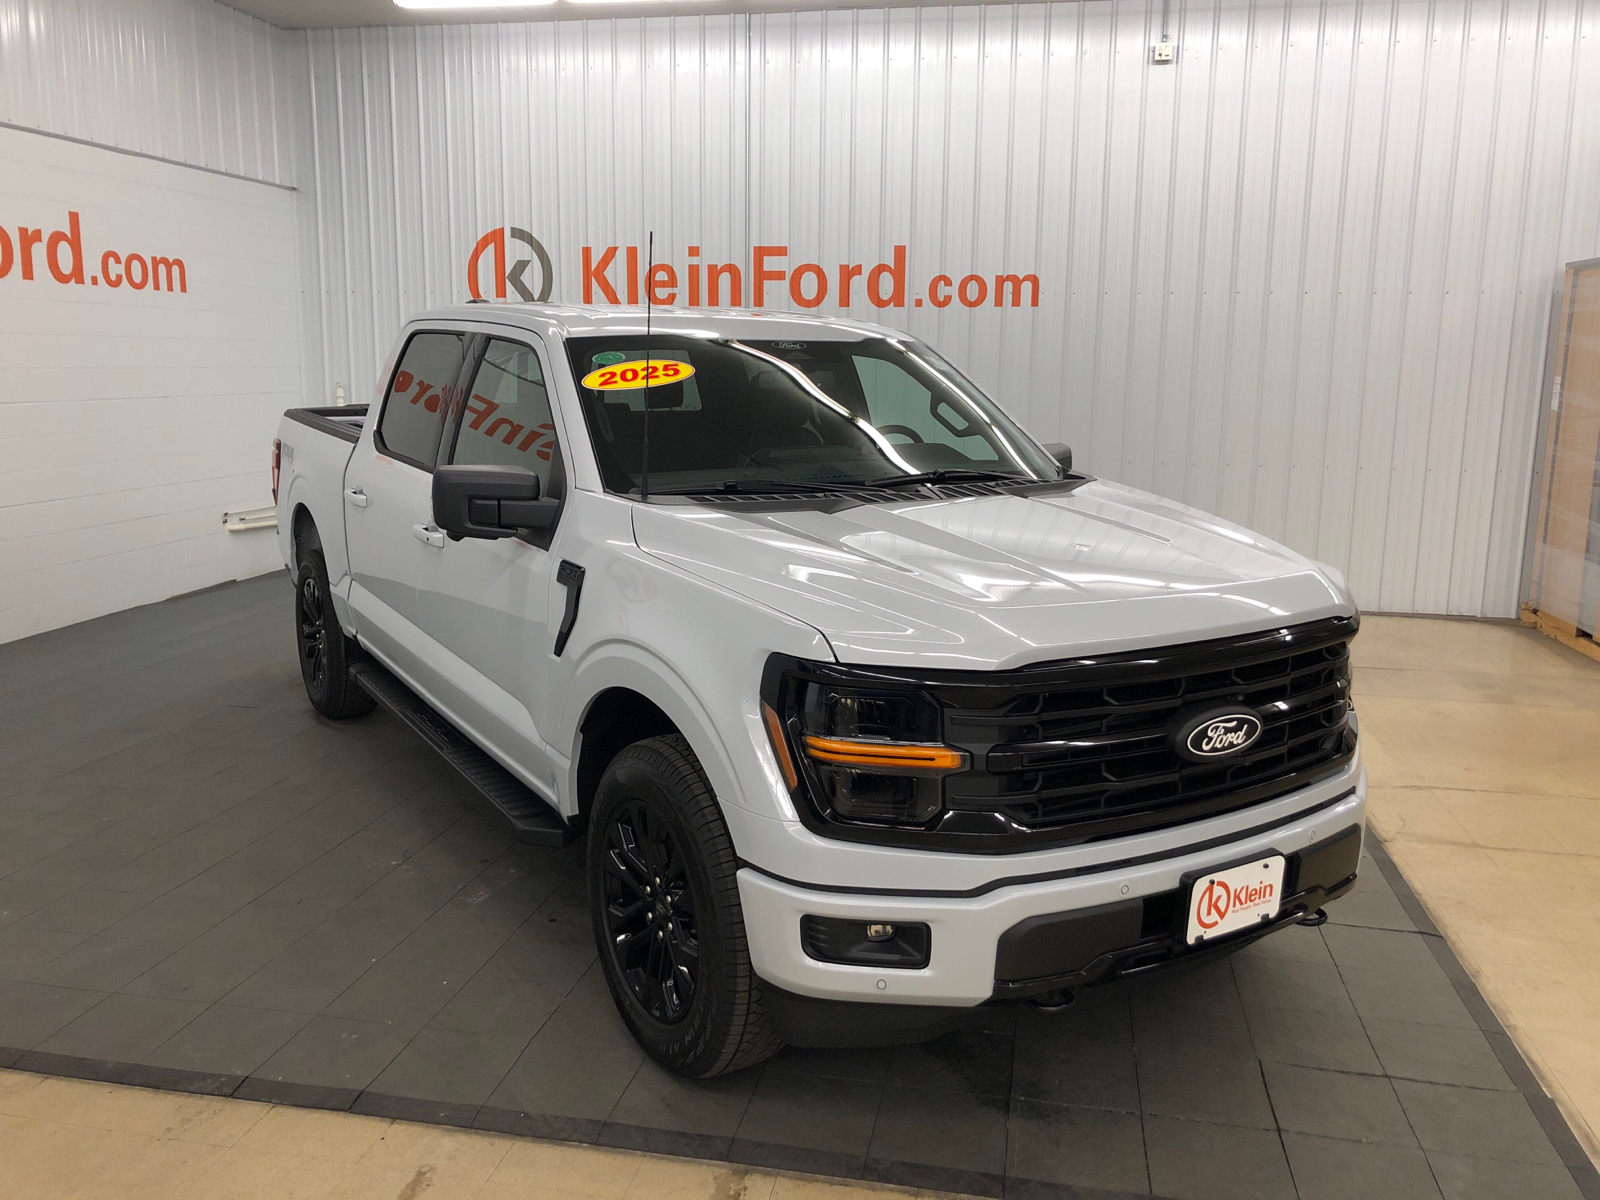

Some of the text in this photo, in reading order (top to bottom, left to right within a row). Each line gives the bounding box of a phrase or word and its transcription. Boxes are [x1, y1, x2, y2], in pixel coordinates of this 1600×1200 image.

[581, 245, 1040, 309] KleinFord.com
[598, 363, 681, 387] 2025
[1202, 720, 1248, 751] Ford
[1231, 880, 1274, 908] Klein
